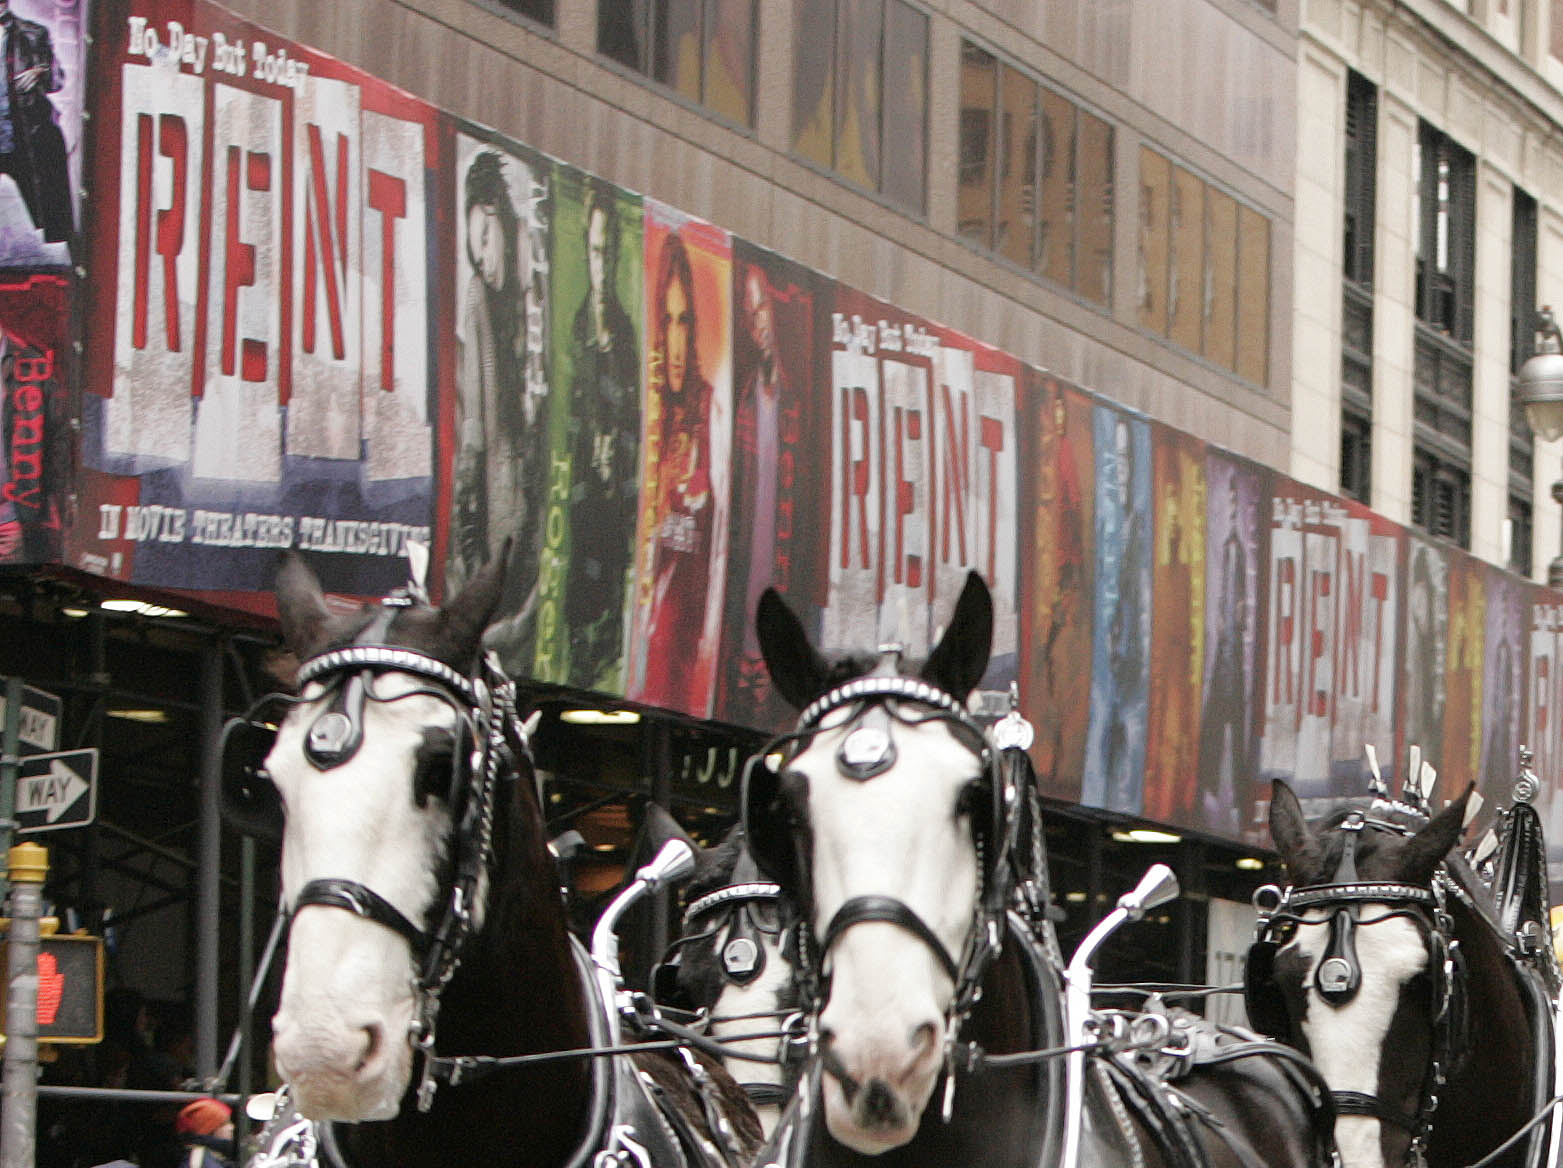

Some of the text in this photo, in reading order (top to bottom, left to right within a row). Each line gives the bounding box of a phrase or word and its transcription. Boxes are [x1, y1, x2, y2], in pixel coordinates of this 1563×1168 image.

[128, 16, 310, 100] No Day But Today
[132, 112, 407, 393] RENT
[4, 350, 54, 509] Benny
[841, 386, 1003, 588] RENT
[98, 504, 122, 540] IN
[124, 505, 187, 542] MOVIE
[191, 509, 295, 549] THEATERS
[1274, 549, 1387, 717] RENT
[29, 776, 72, 807] WAY
